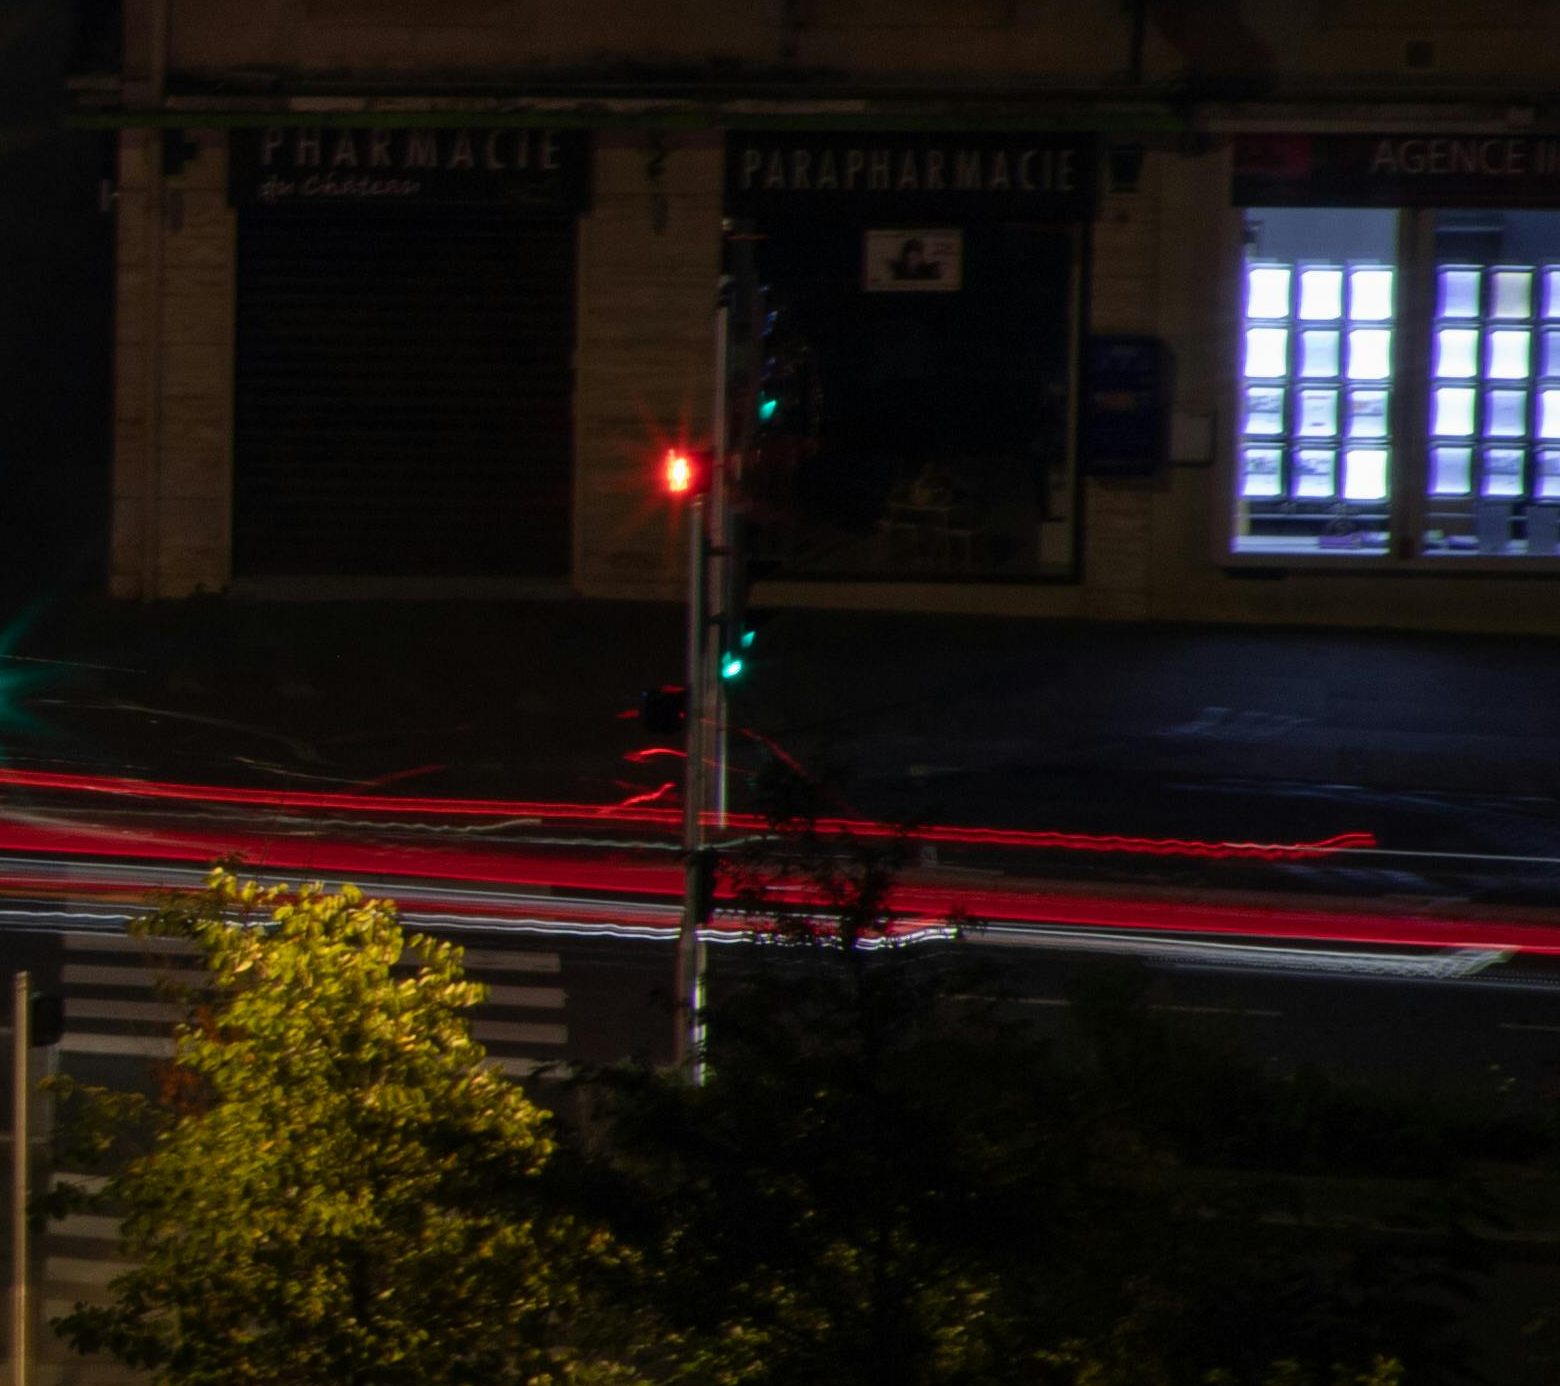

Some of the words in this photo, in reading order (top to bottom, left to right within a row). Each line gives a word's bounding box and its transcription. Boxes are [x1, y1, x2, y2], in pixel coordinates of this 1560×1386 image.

[261, 127, 562, 170] PHARMACIE
[741, 148, 1076, 191] PARAPHARMACIE
[1369, 138, 1526, 175] AGENCE
